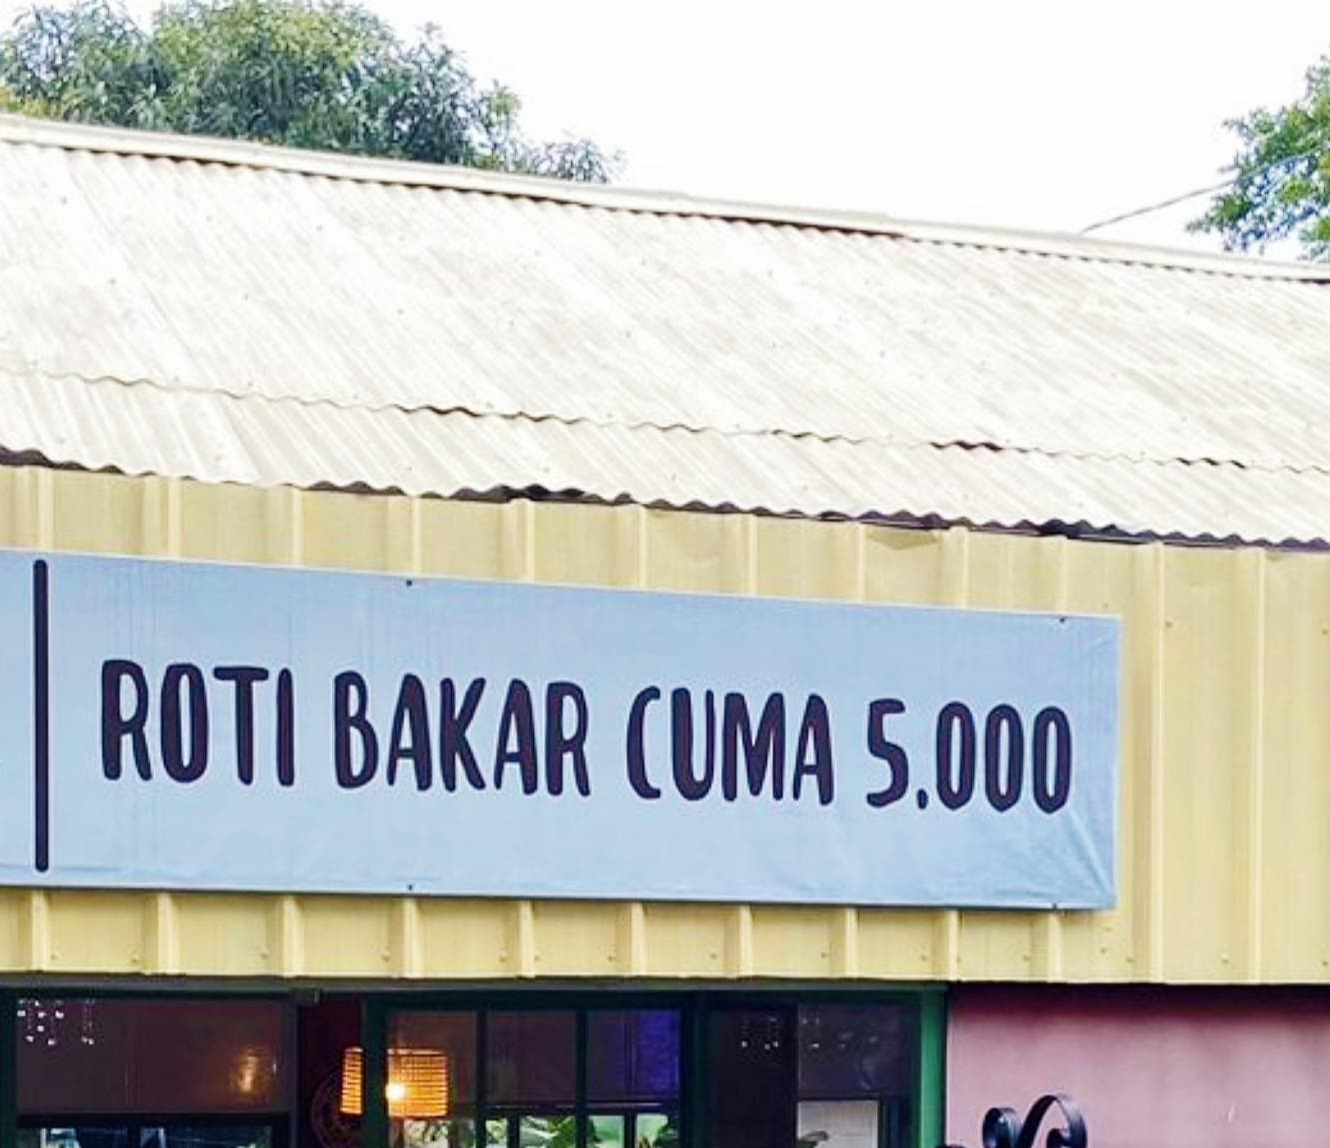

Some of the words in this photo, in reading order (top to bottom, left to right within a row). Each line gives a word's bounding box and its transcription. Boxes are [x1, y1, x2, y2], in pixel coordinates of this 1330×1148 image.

[101, 659, 295, 787] ROTI
[333, 670, 591, 797] BAKAR
[626, 685, 834, 806] CUMA
[866, 698, 1072, 815] 5.000
